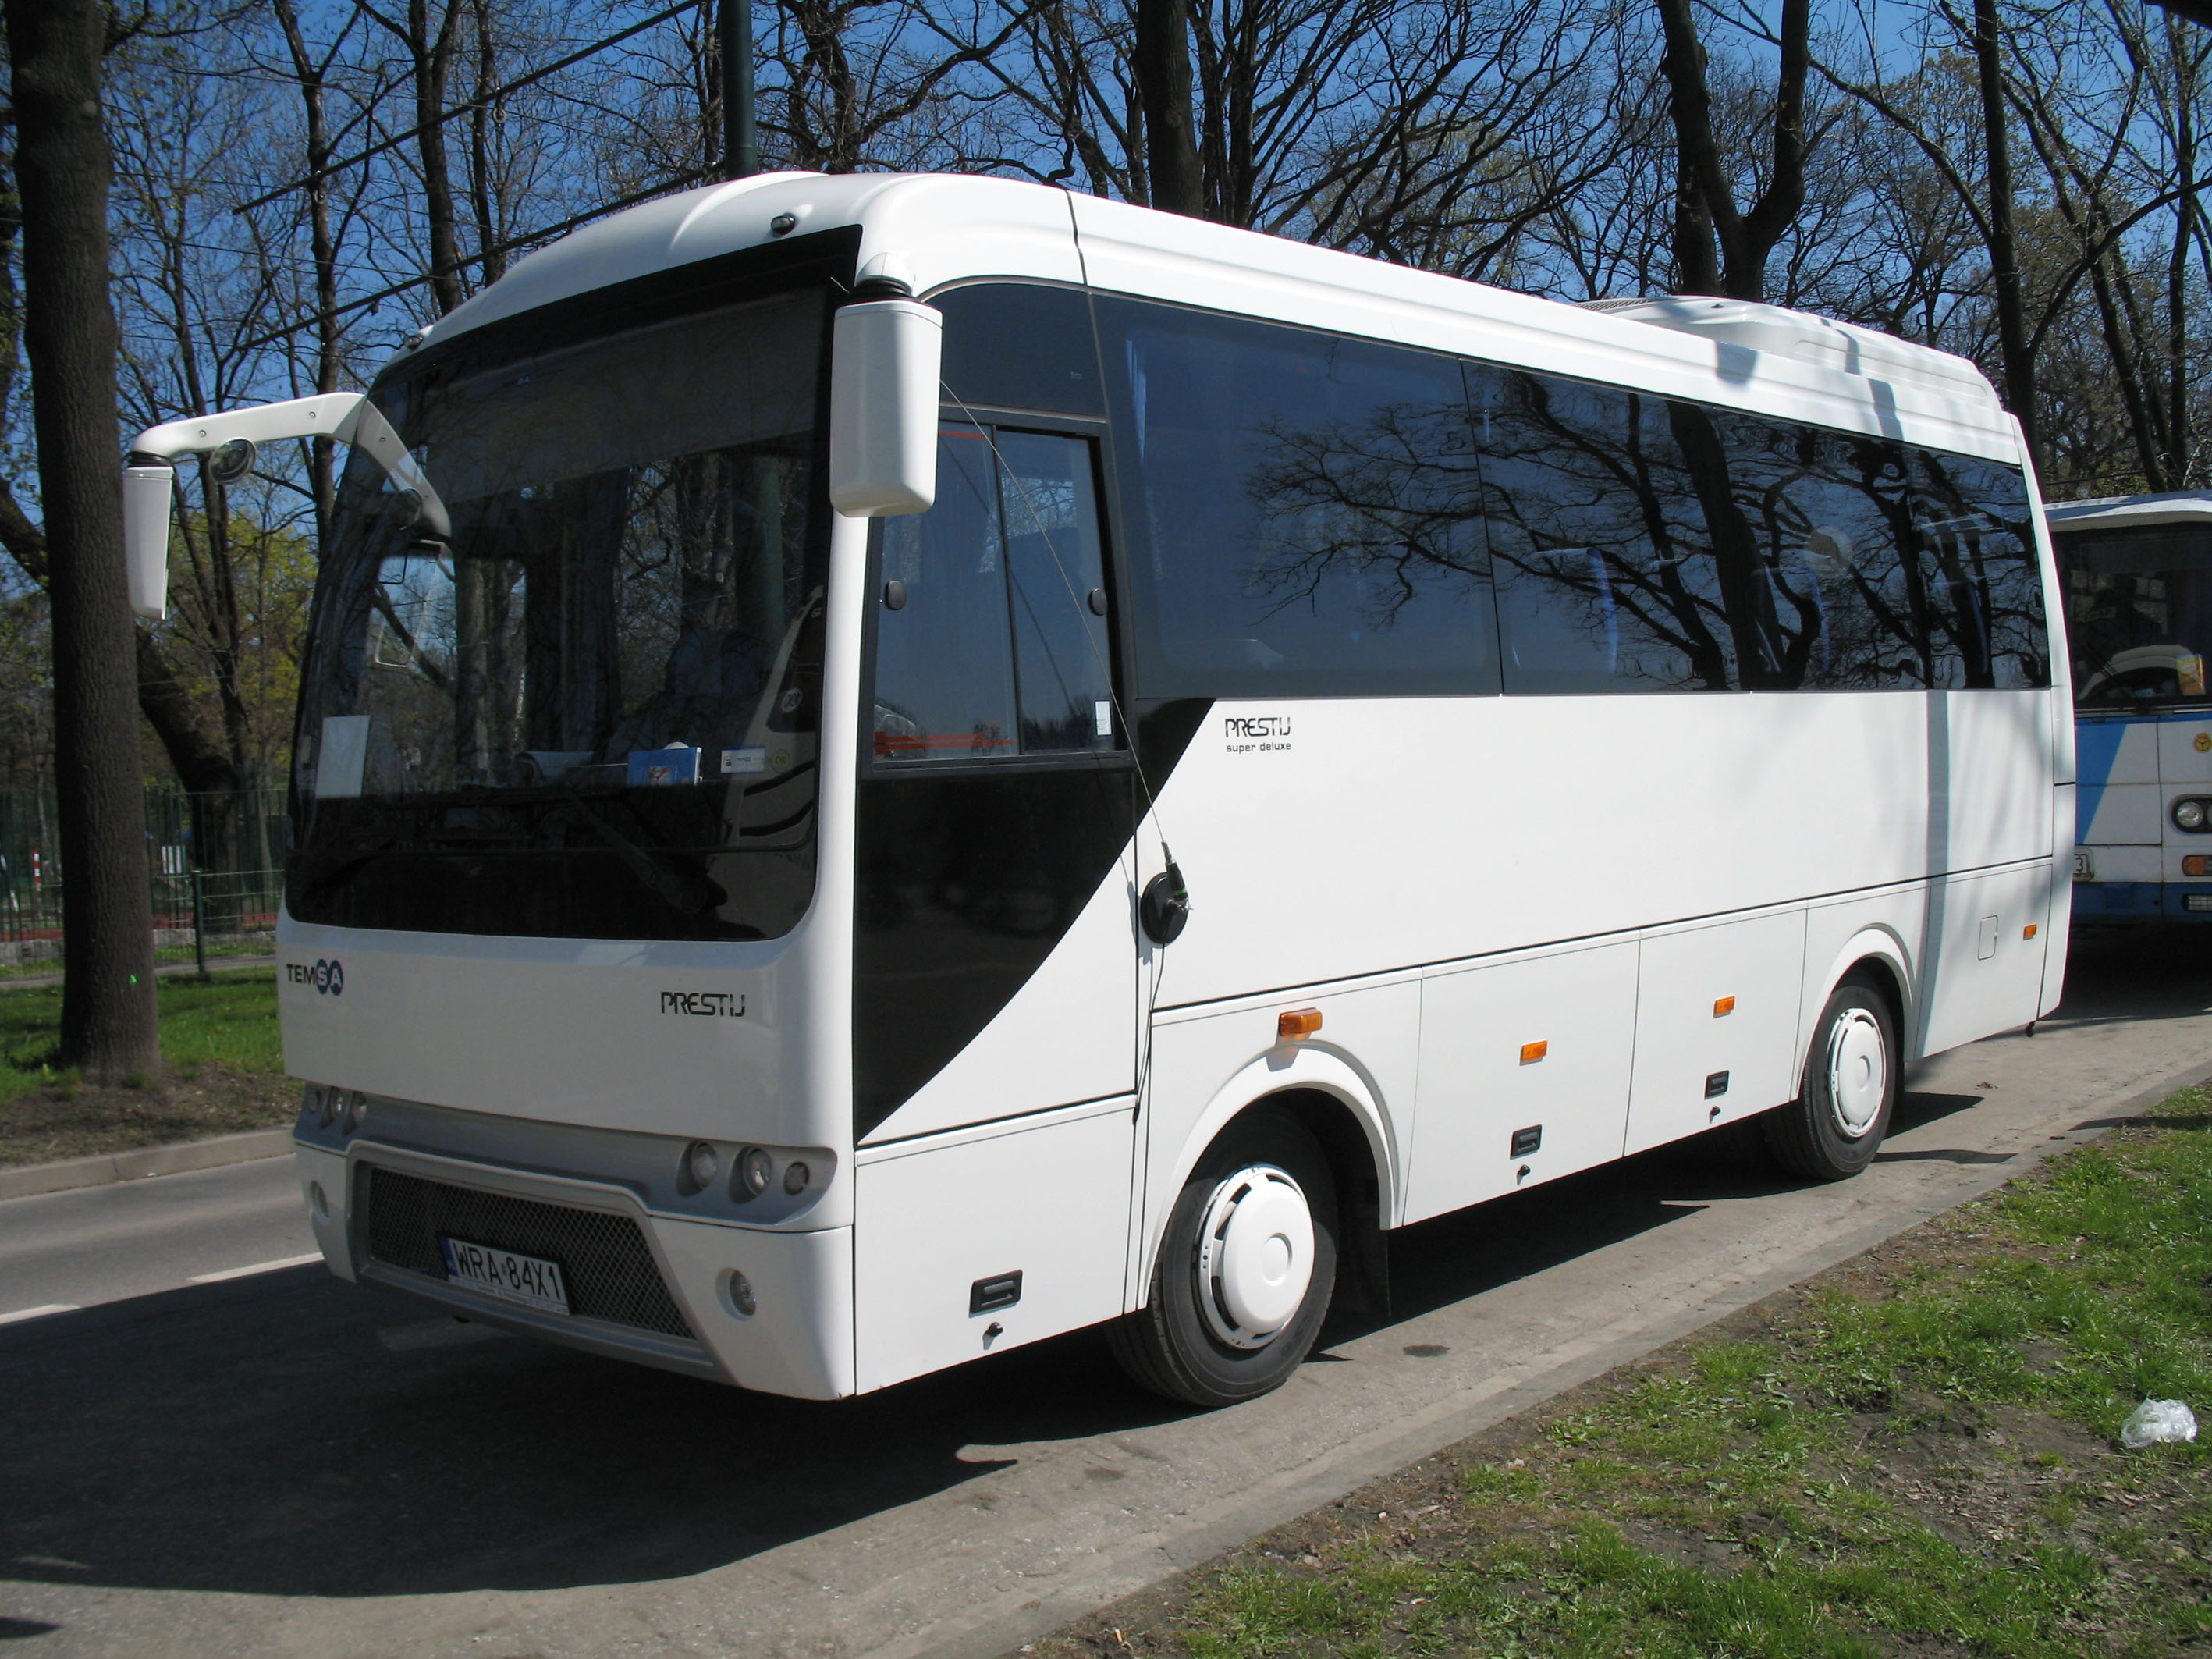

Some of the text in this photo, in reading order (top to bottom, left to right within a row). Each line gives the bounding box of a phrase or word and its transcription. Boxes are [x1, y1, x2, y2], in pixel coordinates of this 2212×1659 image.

[1225, 716, 1291, 737] PRESTIJ
[1226, 741, 1291, 754] super deluxe
[286, 960, 343, 994] TEMSA
[661, 991, 745, 1017] PRESTIJ
[453, 1242, 504, 1286] WRA
[506, 1256, 562, 1300] 84X1
